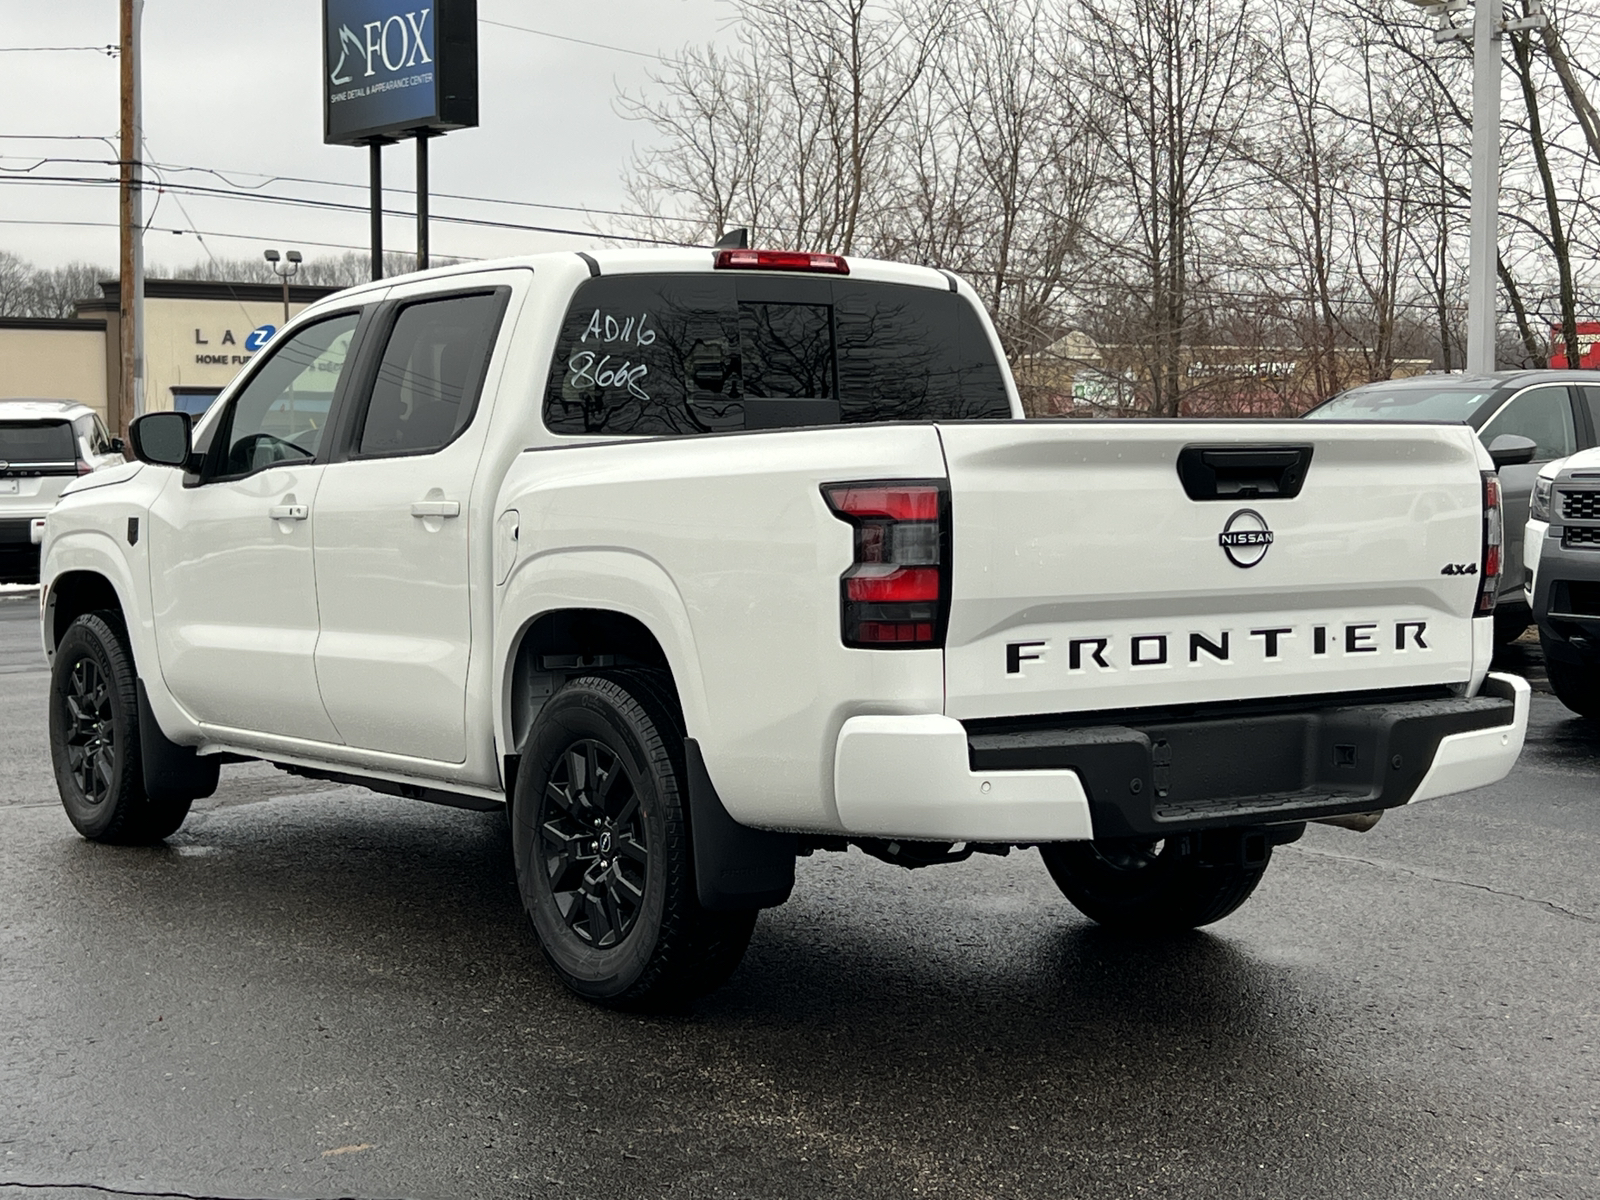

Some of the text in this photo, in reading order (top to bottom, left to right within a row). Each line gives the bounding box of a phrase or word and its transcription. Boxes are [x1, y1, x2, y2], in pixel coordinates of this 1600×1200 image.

[363, 8, 433, 77] FOX
[330, 72, 433, 103] SHINE DETAIL & APPEARANCE CENTER
[1553, 333, 1600, 344] MTRESS
[195, 354, 228, 365] HOME
[1221, 532, 1273, 545] NISSAN
[1005, 621, 1429, 674] FRONTIER
